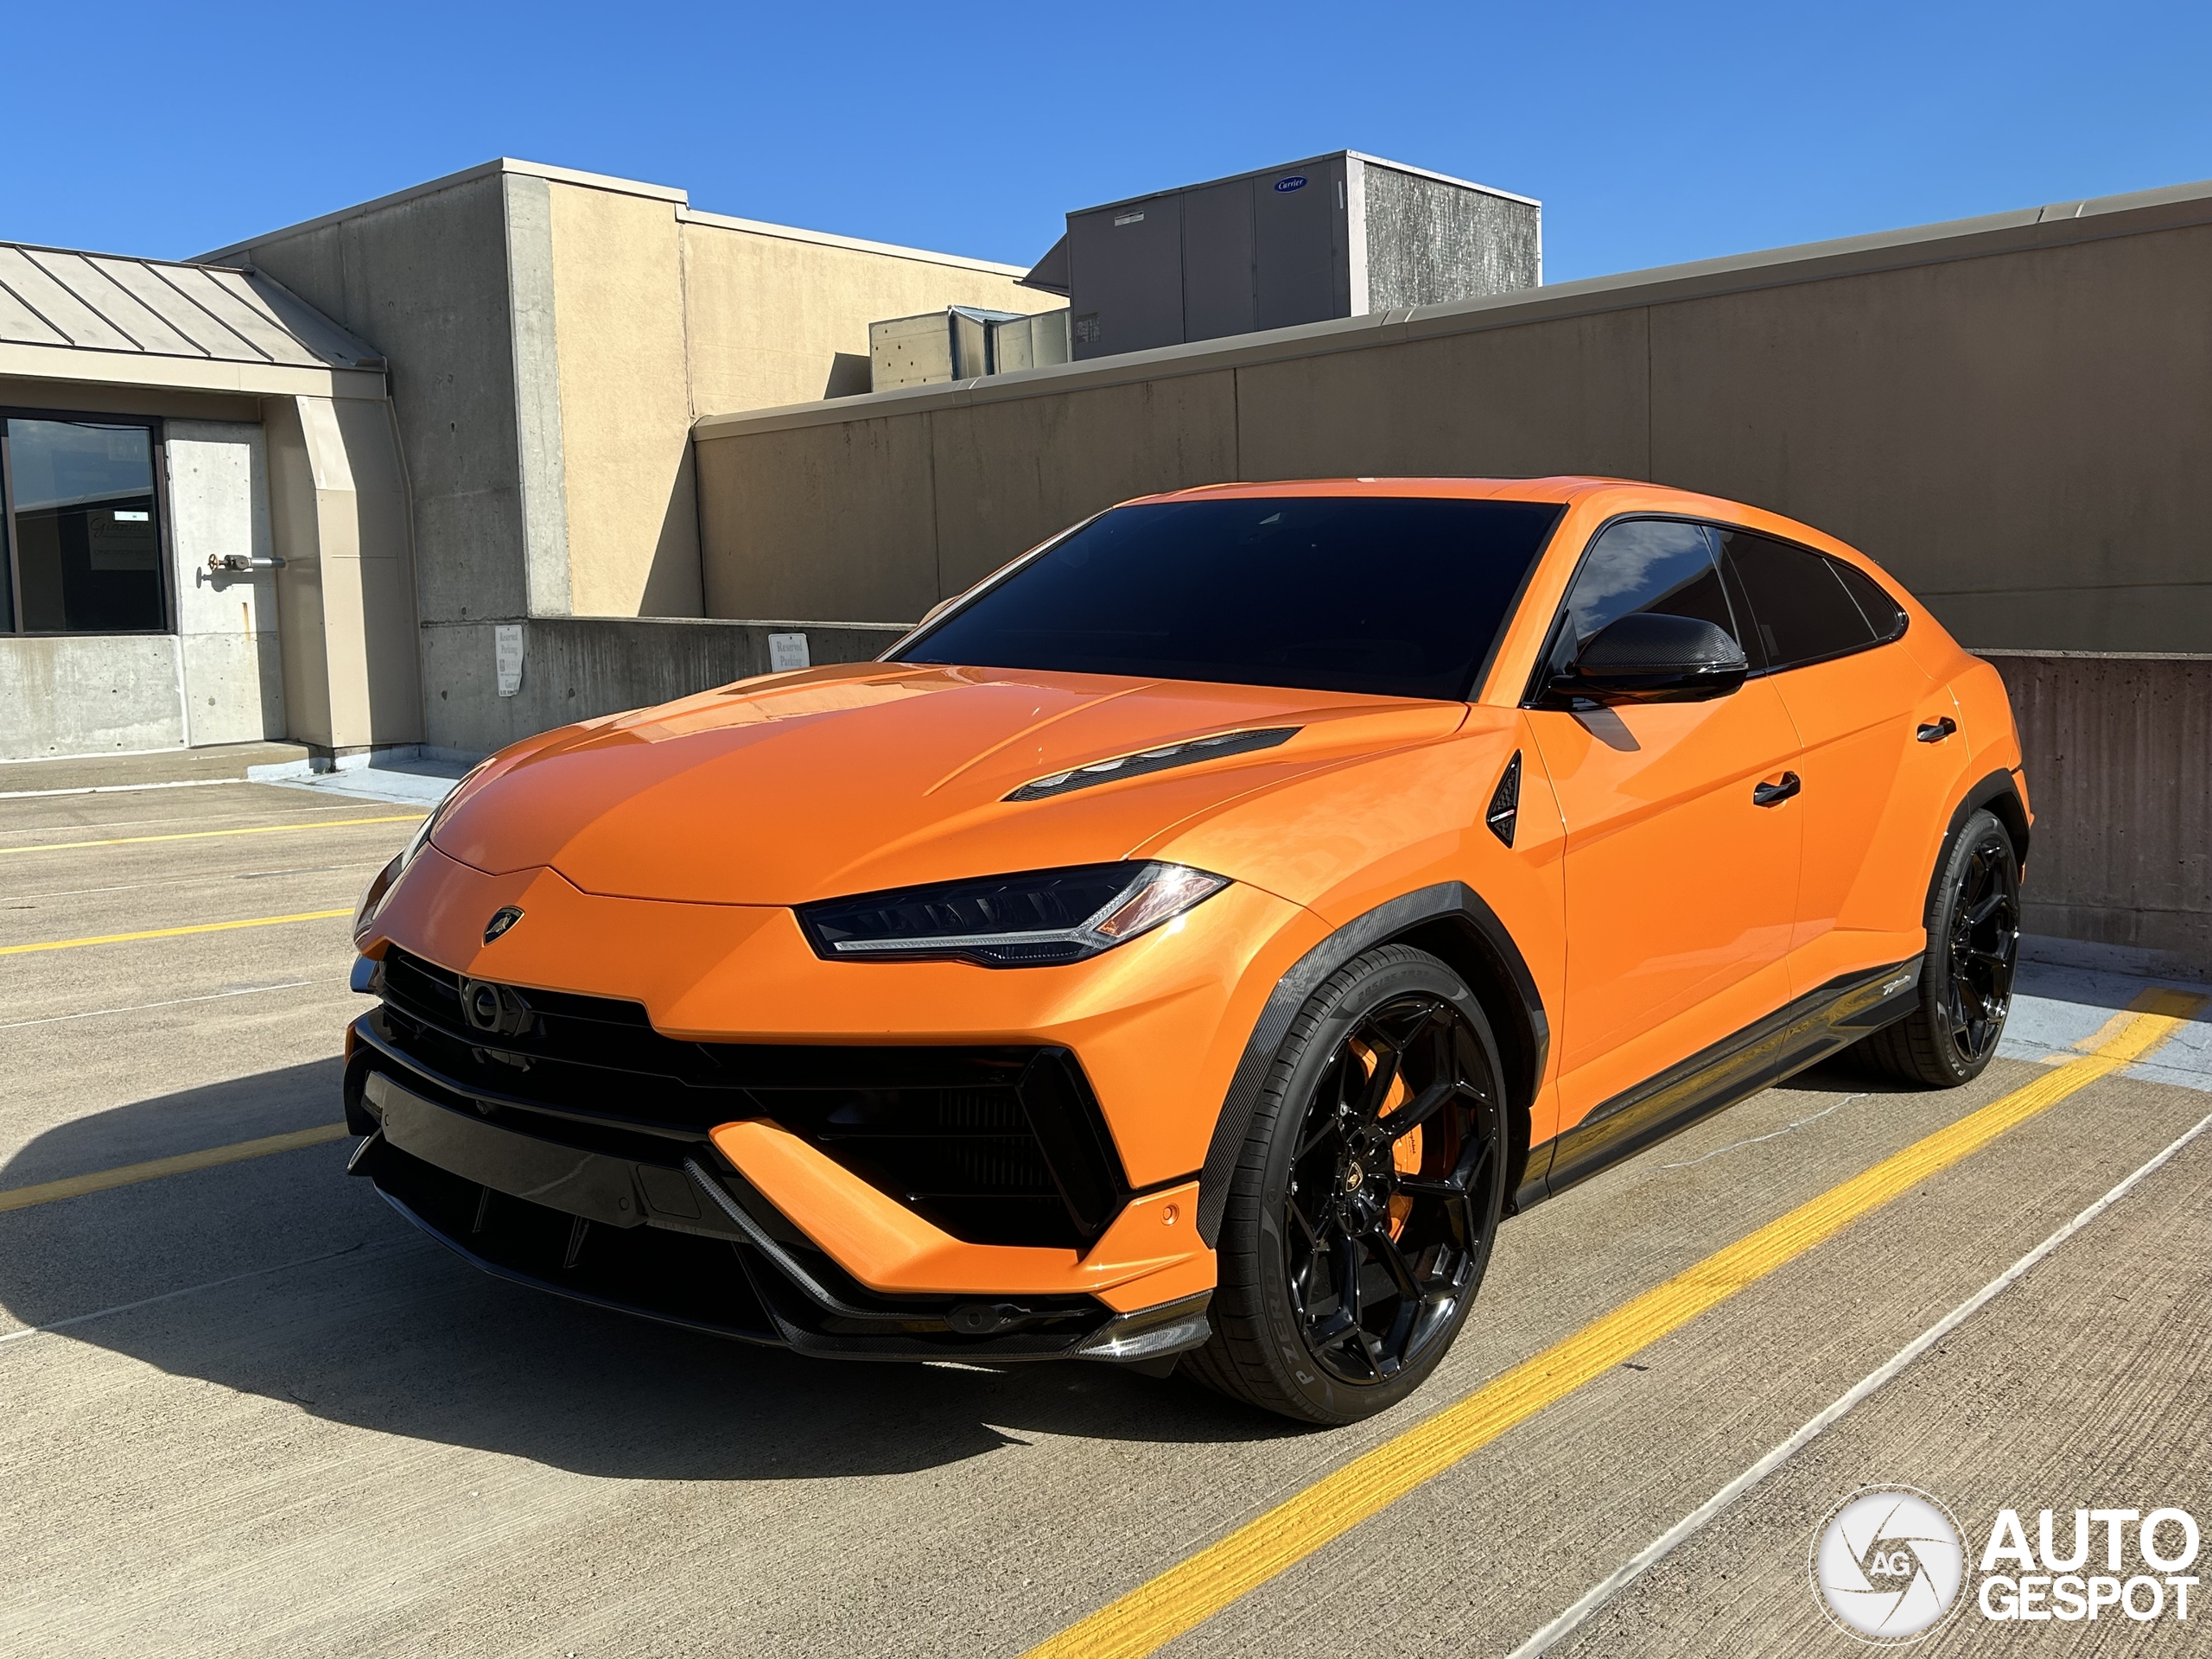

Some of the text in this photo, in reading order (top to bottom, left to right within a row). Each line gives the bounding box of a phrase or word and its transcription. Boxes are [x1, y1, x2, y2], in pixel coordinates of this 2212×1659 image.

[1278, 179, 1304, 190] Carrier
[499, 632, 518, 642] Reserved
[501, 644, 518, 656] Parking
[776, 639, 803, 652] Reserved
[779, 654, 803, 667] Parking
[1267, 1272, 1314, 1385] P ZERO
